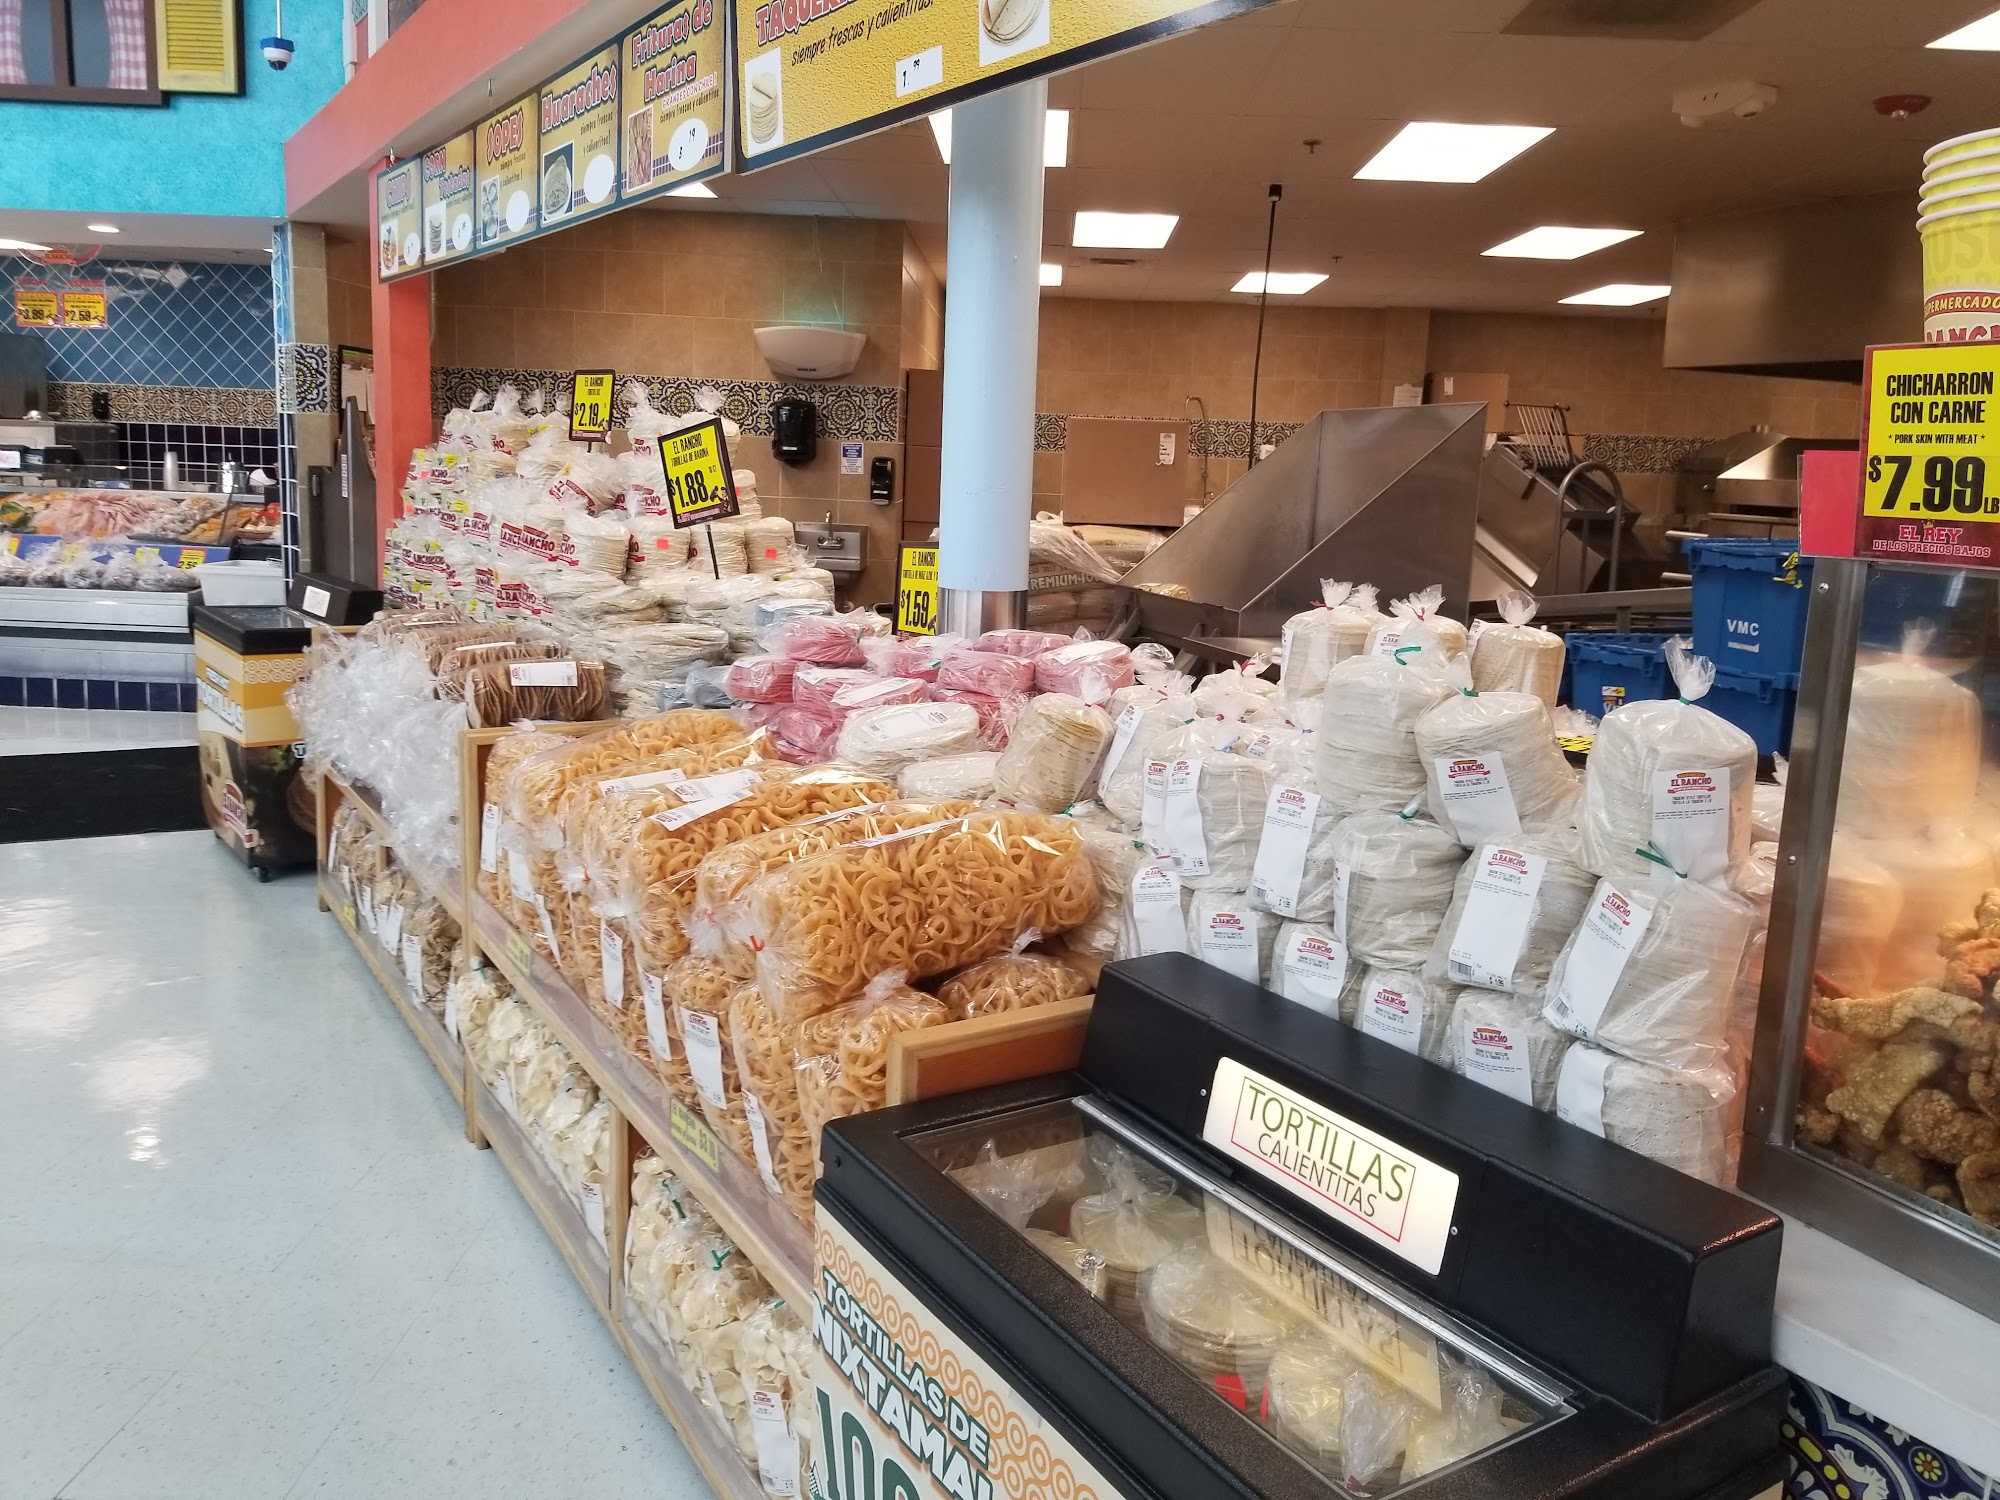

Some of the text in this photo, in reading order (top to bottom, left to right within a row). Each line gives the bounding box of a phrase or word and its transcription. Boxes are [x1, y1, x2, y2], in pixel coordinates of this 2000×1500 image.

[631, 0, 713, 68] Frituras de
[791, 37, 827, 67] siempre
[828, 18, 865, 49] frescas
[866, 15, 874, 42] y
[643, 52, 698, 104] Harina
[541, 61, 618, 135] Huaraches
[486, 106, 524, 166] SOPES
[1886, 371, 1994, 397] CHICHARRON
[574, 402, 599, 427] $2.19
[1890, 400, 1987, 424] CON CARNE
[672, 433, 703, 454] EL RANCHO
[1894, 434, 1978, 445] PORK SKIN WITH MEAT
[688, 452, 694, 463] DE
[693, 447, 709, 461] HARINA
[669, 469, 709, 509] $1.88
[1868, 455, 2000, 514] $7.99 LB
[1898, 525, 1963, 544] EL REY
[1873, 539, 1991, 557] DE LOS PRECIOS BAJOS
[912, 551, 936, 568] EL RANCHO
[900, 589, 930, 628] $1.59
[1726, 619, 1760, 637] VMC
[1457, 763, 1485, 772] RANCHO
[1671, 777, 1712, 787] EL RANCHO
[1491, 853, 1527, 868] EL RANCHO
[1611, 897, 1631, 918] RANCHO
[1307, 942, 1333, 954] RANCHO
[1382, 994, 1406, 1007] RANCHO
[1479, 1033, 1508, 1043] RANCHO
[1248, 1084, 1408, 1202] TORTILLAS
[1257, 1132, 1377, 1218] CALIENTITAS
[822, 1265, 990, 1471] TORTILLAS DE
